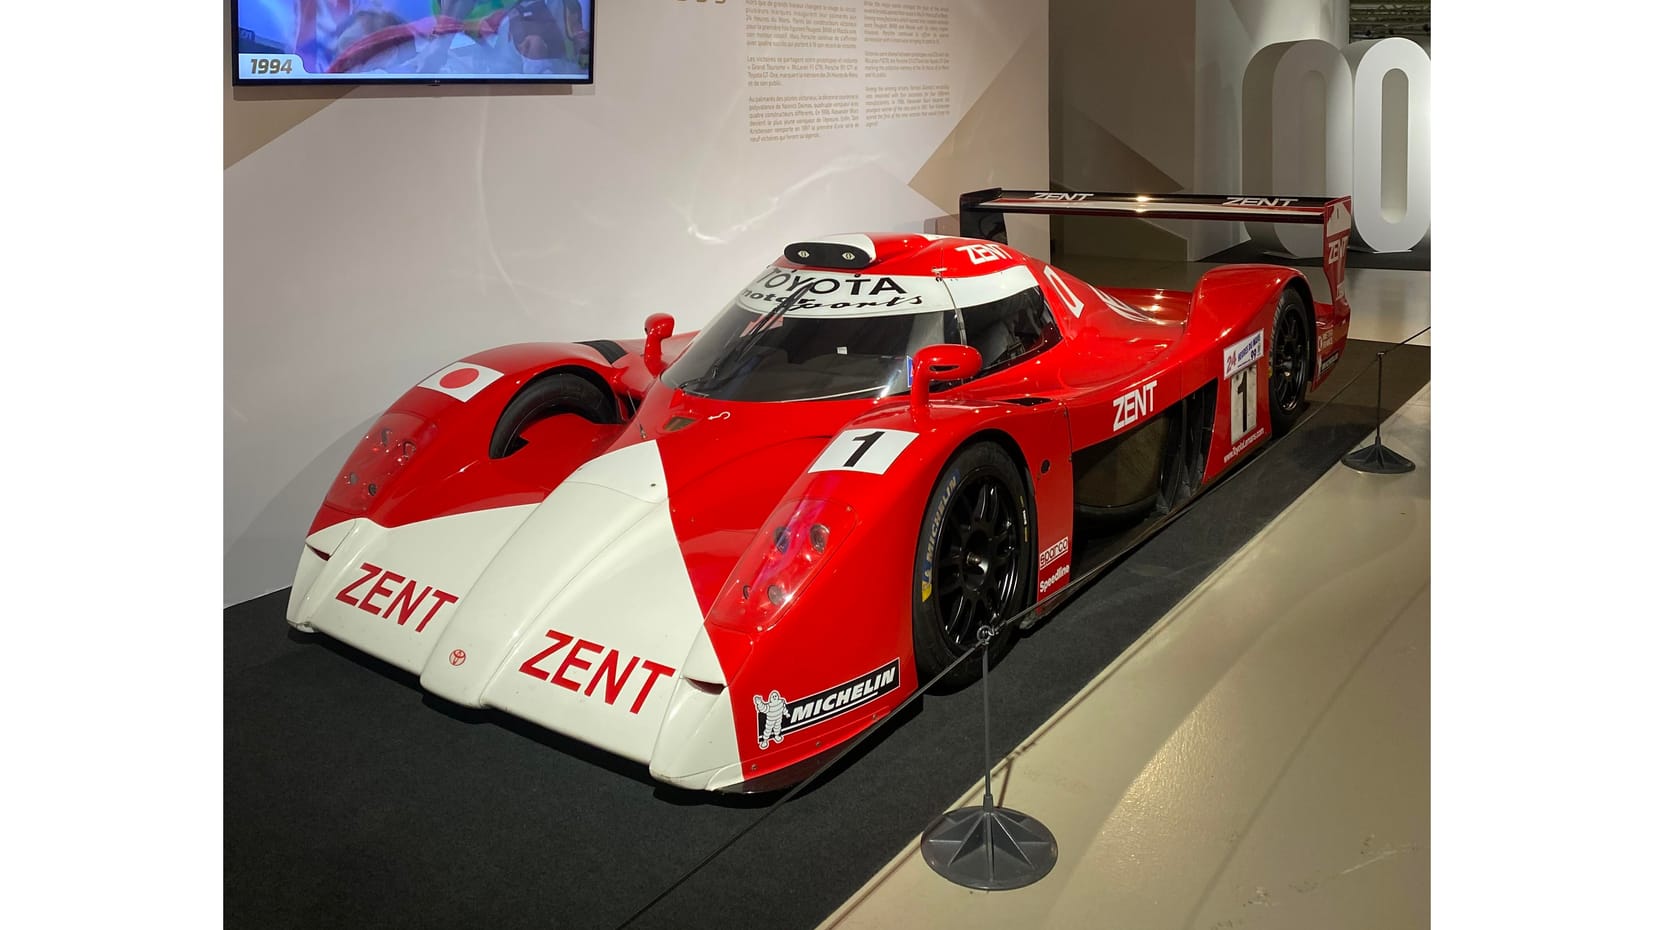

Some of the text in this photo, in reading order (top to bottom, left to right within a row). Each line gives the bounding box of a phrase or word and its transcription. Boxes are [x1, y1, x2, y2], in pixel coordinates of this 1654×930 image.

[251, 59, 292, 74] 1994
[1031, 192, 1094, 202] ZENT
[1221, 197, 1298, 207] ZENT
[955, 244, 1013, 266] ZENT
[756, 267, 907, 296] TOYOTA
[1226, 350, 1237, 374] 24
[1112, 380, 1158, 432] ZENT
[1237, 371, 1248, 433] 1
[843, 431, 885, 468] 1
[1040, 538, 1069, 567] sparco
[1039, 564, 1070, 593] Speedline
[335, 562, 459, 633] ZENT
[518, 629, 677, 715] ZENT
[790, 666, 897, 724] MICHELIN
